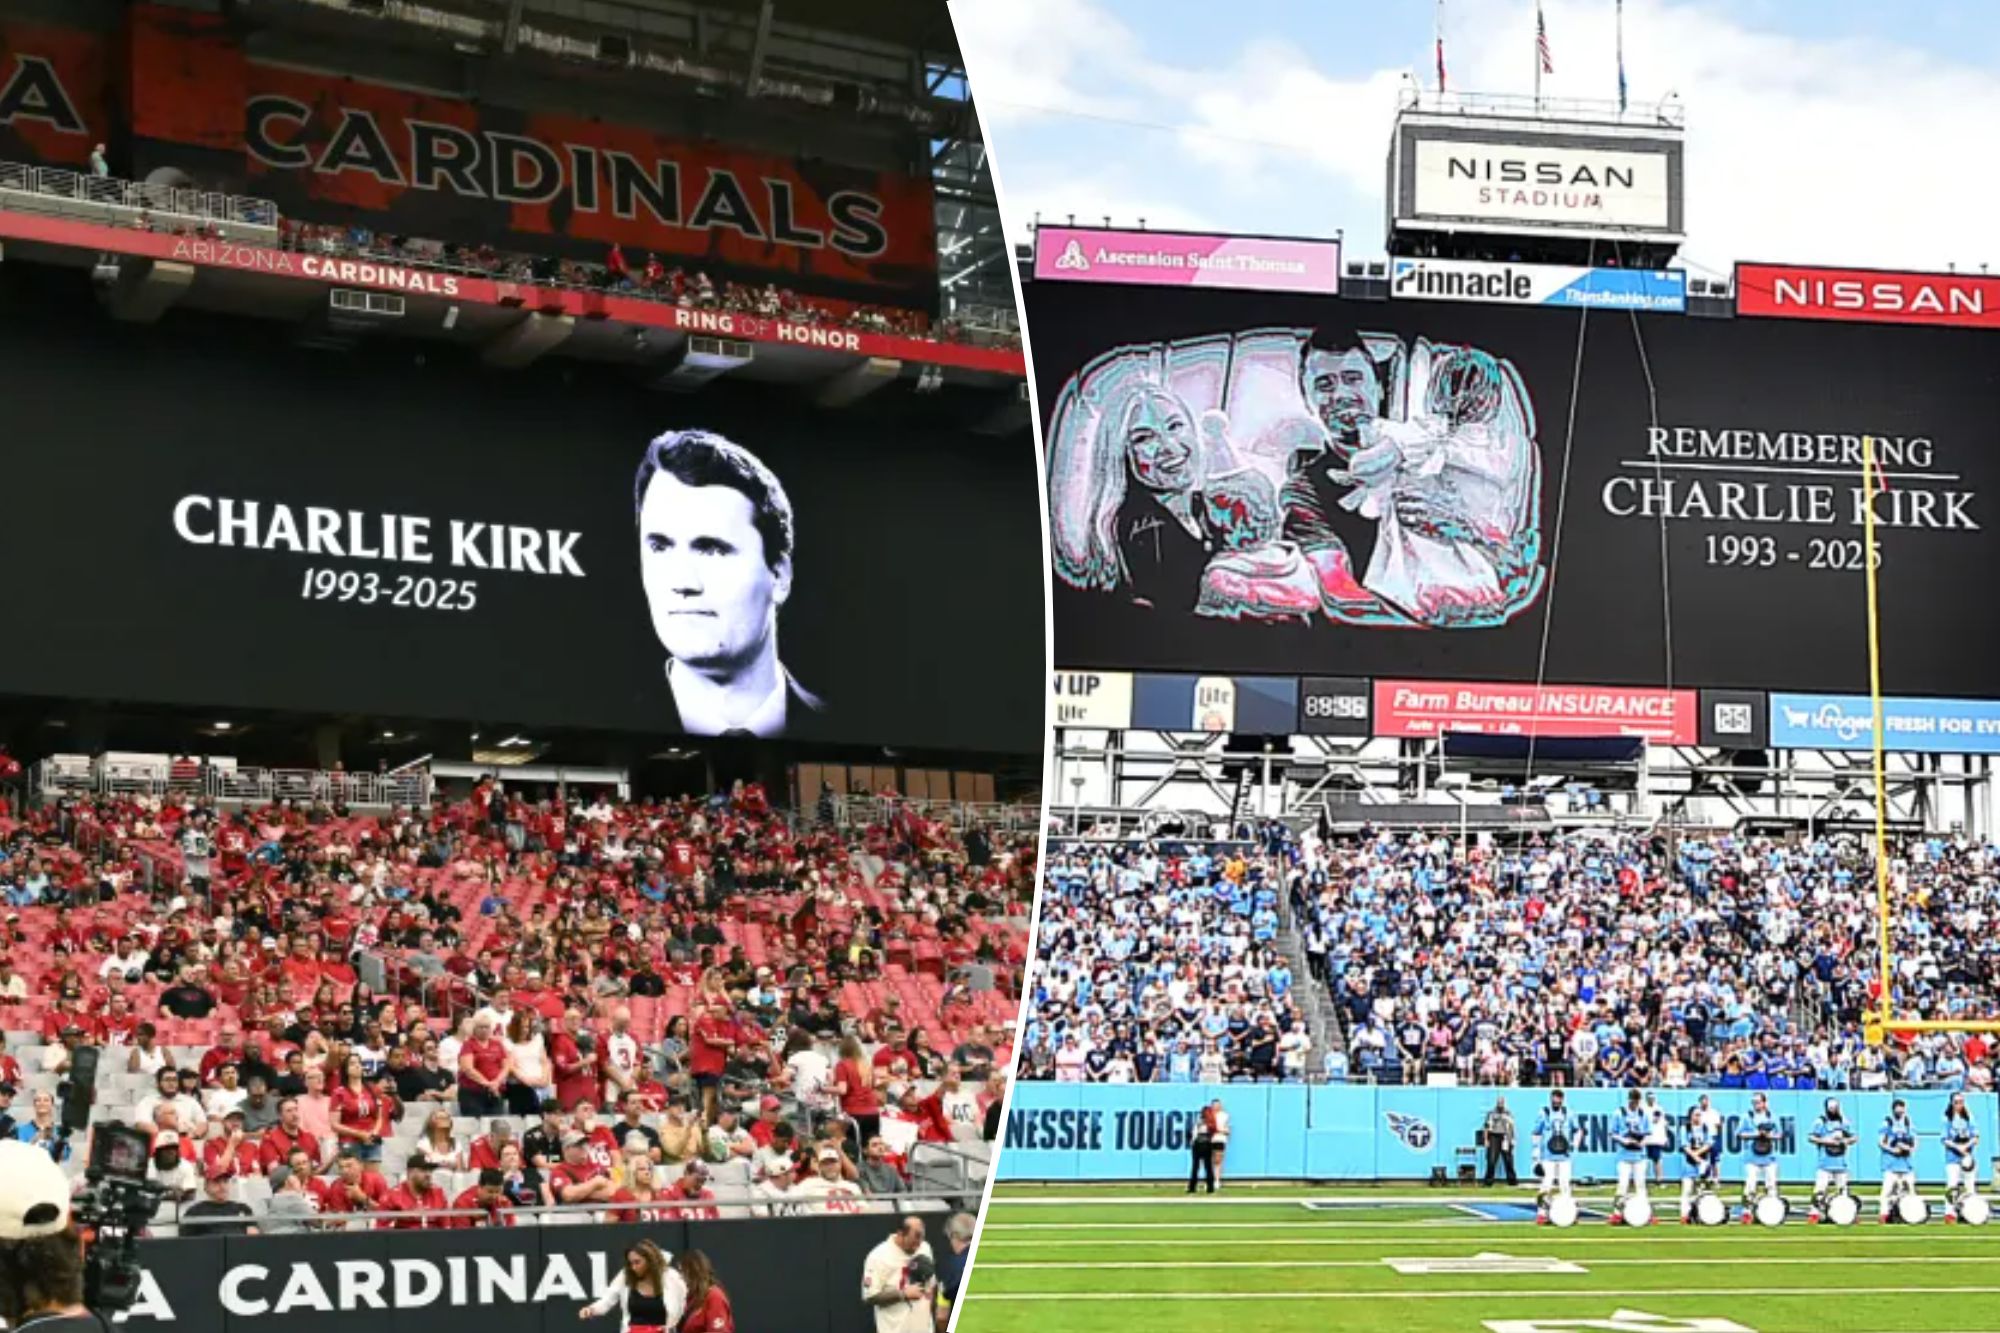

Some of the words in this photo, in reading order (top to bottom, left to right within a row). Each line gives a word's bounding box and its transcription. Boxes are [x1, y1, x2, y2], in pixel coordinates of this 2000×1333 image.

[246, 95, 887, 258] CARDINALS
[1449, 156, 1634, 189] NISSAN
[1479, 187, 1603, 210] STADIUM
[173, 240, 293, 273] ARIZONA
[302, 257, 459, 296] CARDINALS
[1095, 248, 1183, 268] Ascension
[1187, 252, 1235, 270] Saint
[1396, 263, 1531, 299] Pinnacle
[1774, 279, 1982, 314] NISSAN
[676, 309, 733, 333] RING
[740, 317, 770, 335] OF
[777, 325, 860, 351] HONOR
[1647, 427, 1932, 467] REMEMBERING
[1602, 477, 1835, 523] CHARLIE
[1851, 487, 1981, 530] KIRK
[173, 495, 433, 563] CHARLIE
[450, 519, 586, 577] KIRK
[1704, 535, 1776, 566] 1993
[1808, 539, 1881, 570] 2025
[302, 568, 478, 611] 1993-2025
[1069, 675, 1100, 696] UP
[1393, 688, 1450, 709] Farm
[1455, 690, 1533, 712] Bureau
[1538, 693, 1676, 717] INSURANCE
[1939, 718, 1973, 734] FOR
[1004, 1109, 1103, 1149] NESSEE
[218, 1250, 674, 1316] CARDINAL
